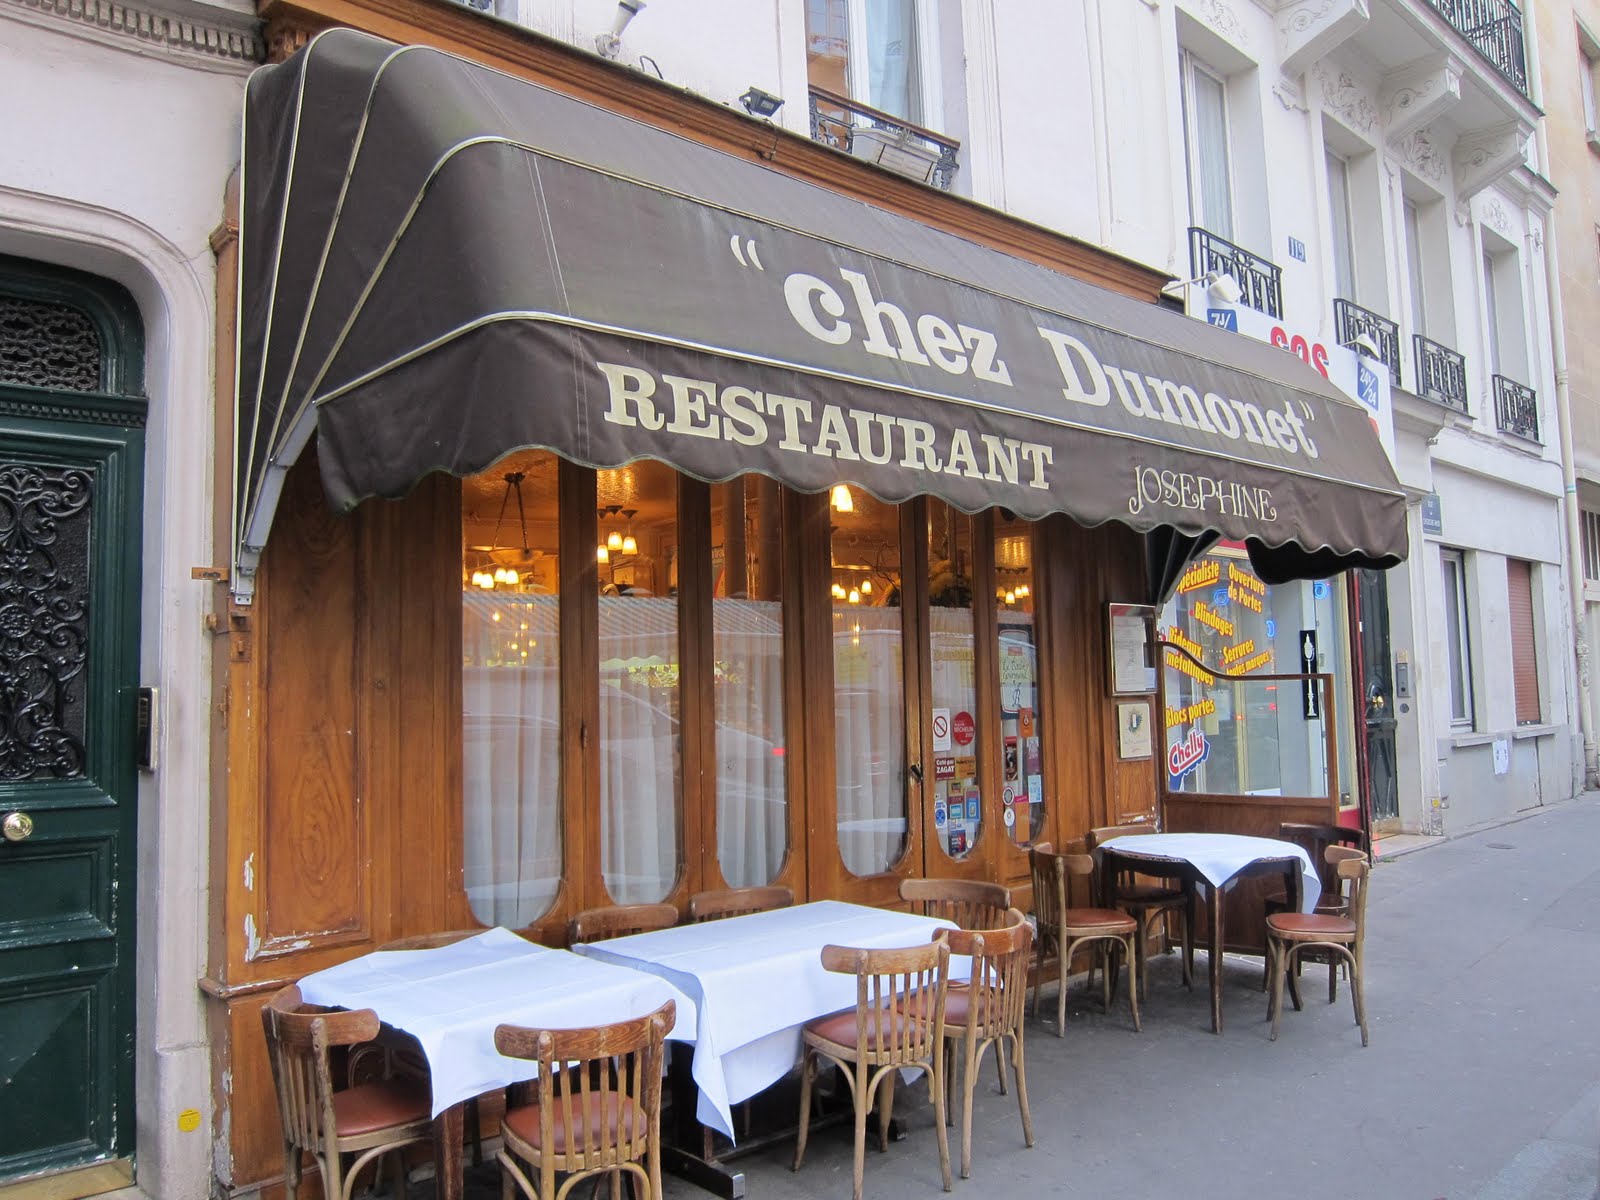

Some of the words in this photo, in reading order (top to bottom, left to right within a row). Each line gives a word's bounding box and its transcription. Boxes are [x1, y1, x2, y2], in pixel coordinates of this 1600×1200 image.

[597, 361, 1054, 490] RESTAURANT
[1129, 464, 1277, 522] JOSEPHINE
[1176, 559, 1220, 594] pécialiste
[1228, 562, 1265, 596] Ouverture
[1228, 581, 1237, 601] de
[1238, 587, 1263, 613] Portes
[1194, 601, 1234, 636] Blindages
[1168, 625, 1202, 660] Rideaux
[1223, 639, 1255, 664] Serrures
[1245, 651, 1270, 672] marques
[1166, 705, 1187, 727] Blocs
[1188, 699, 1215, 724] portes
[936, 766, 955, 774] ZAGAT
